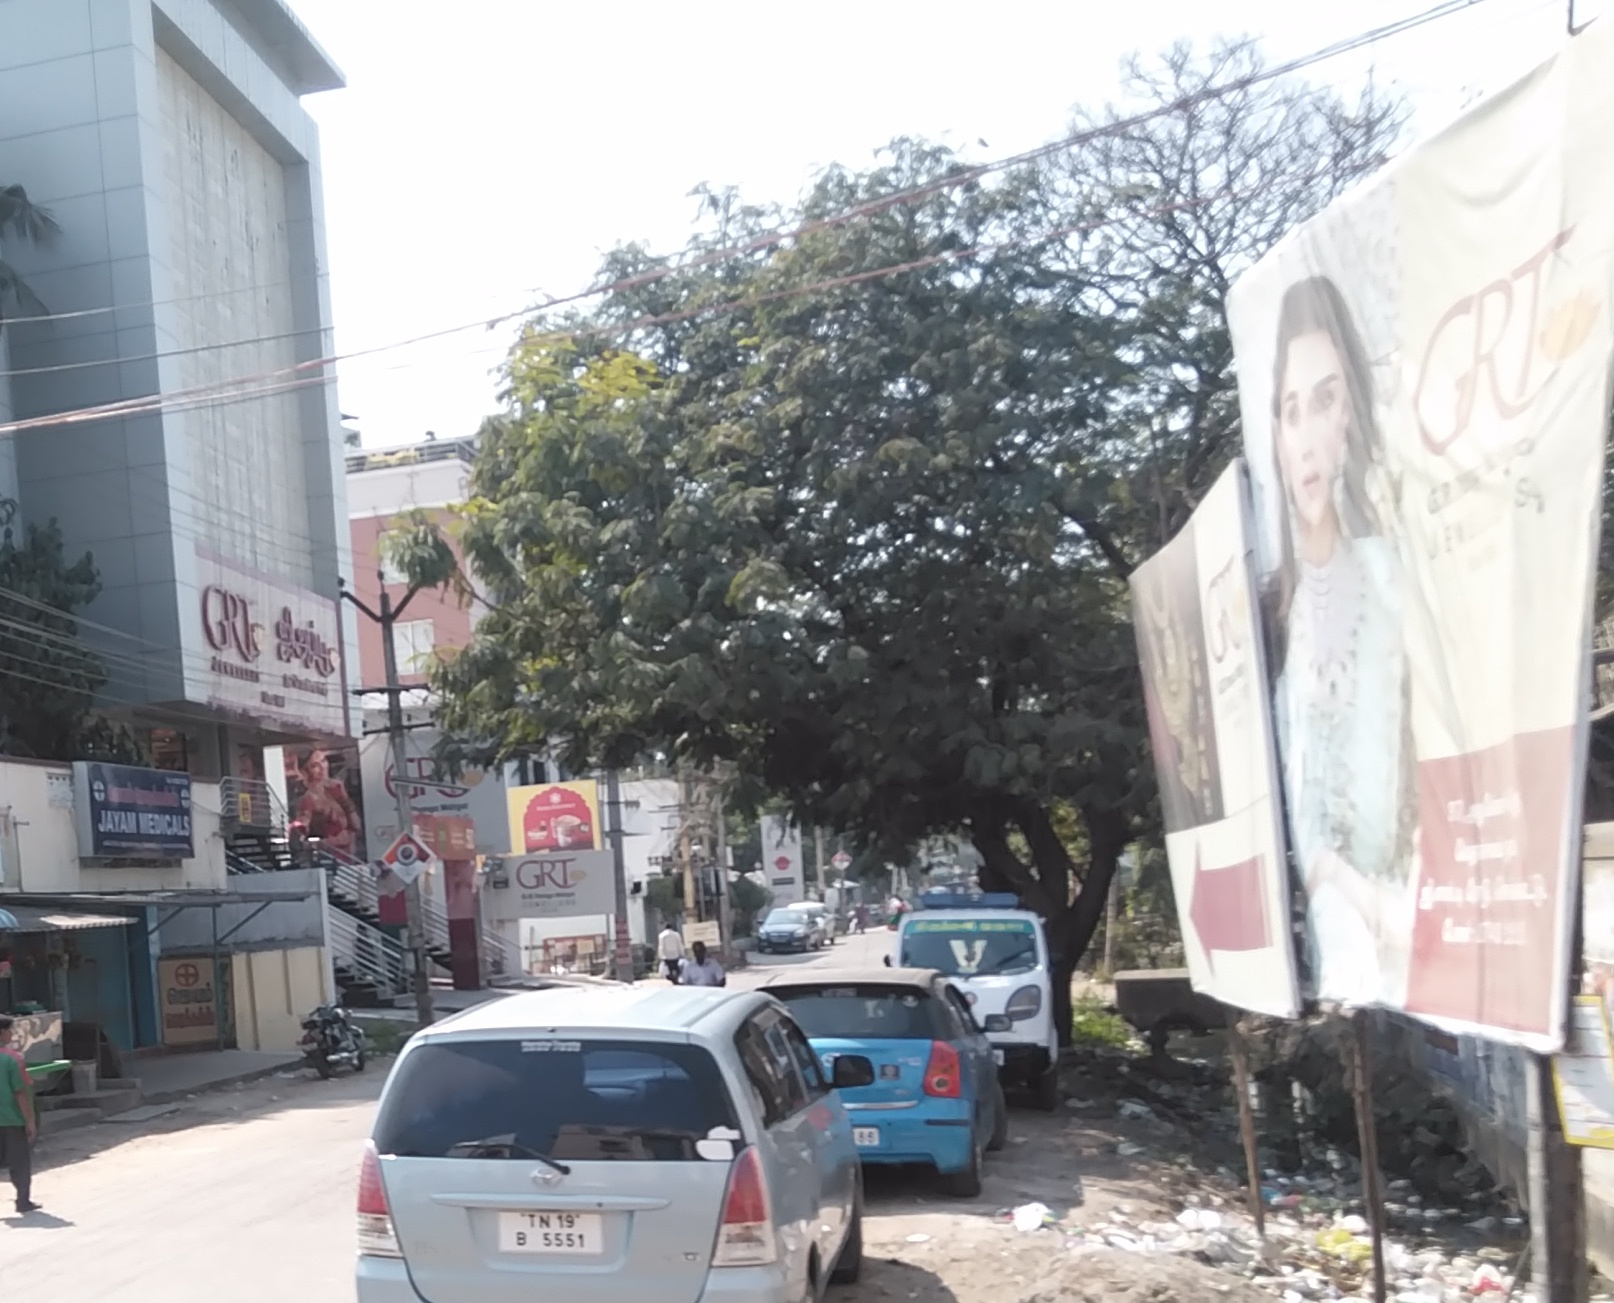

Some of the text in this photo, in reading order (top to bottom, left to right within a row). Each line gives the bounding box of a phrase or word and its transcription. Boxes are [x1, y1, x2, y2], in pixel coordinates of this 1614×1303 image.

[1412, 222, 1578, 457] GRT
[202, 585, 262, 663] GRT
[98, 809, 190, 836] JAYAM MEDICALS
[516, 857, 578, 889] GRT
[527, 1213, 576, 1229] TN 19
[516, 1231, 585, 1248] B 5551
